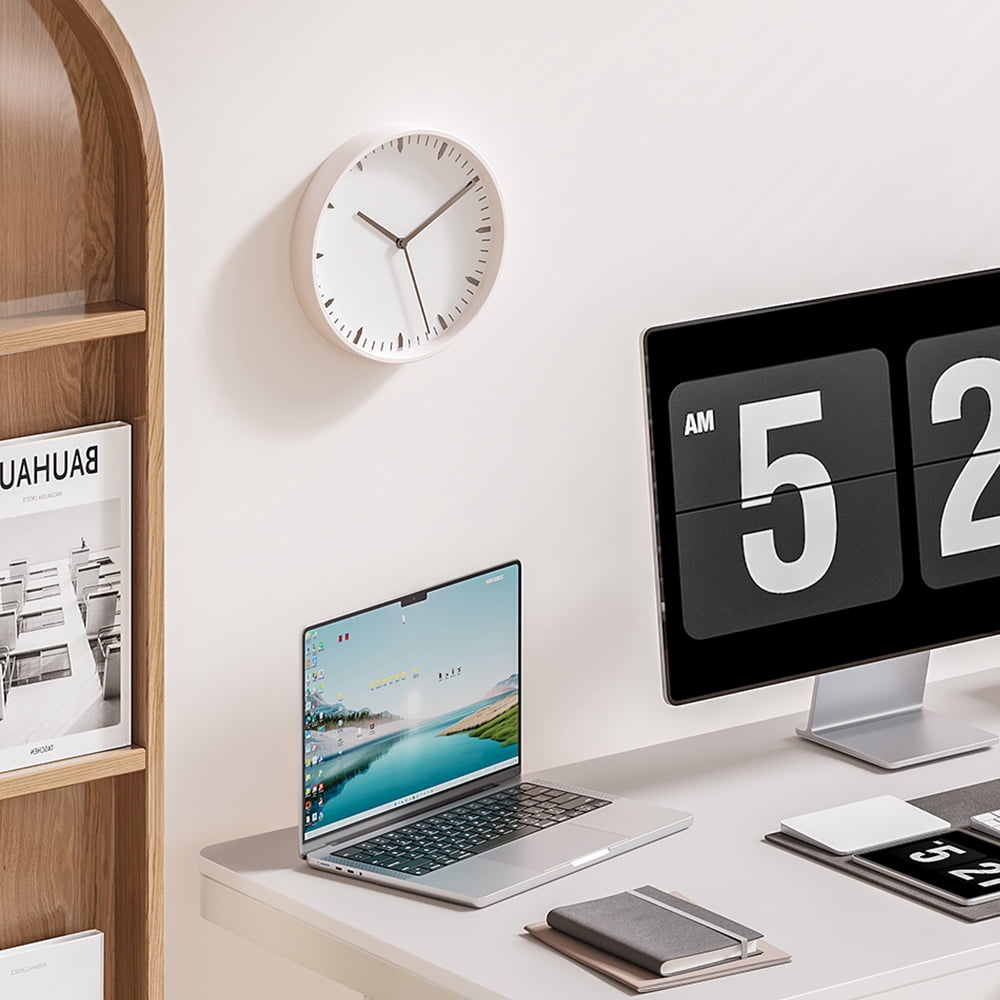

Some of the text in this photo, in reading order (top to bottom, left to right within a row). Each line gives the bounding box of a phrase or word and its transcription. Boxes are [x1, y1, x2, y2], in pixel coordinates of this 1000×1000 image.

[684, 409, 716, 436] AM
[738, 390, 839, 595] 5
[909, 844, 967, 863] 5
